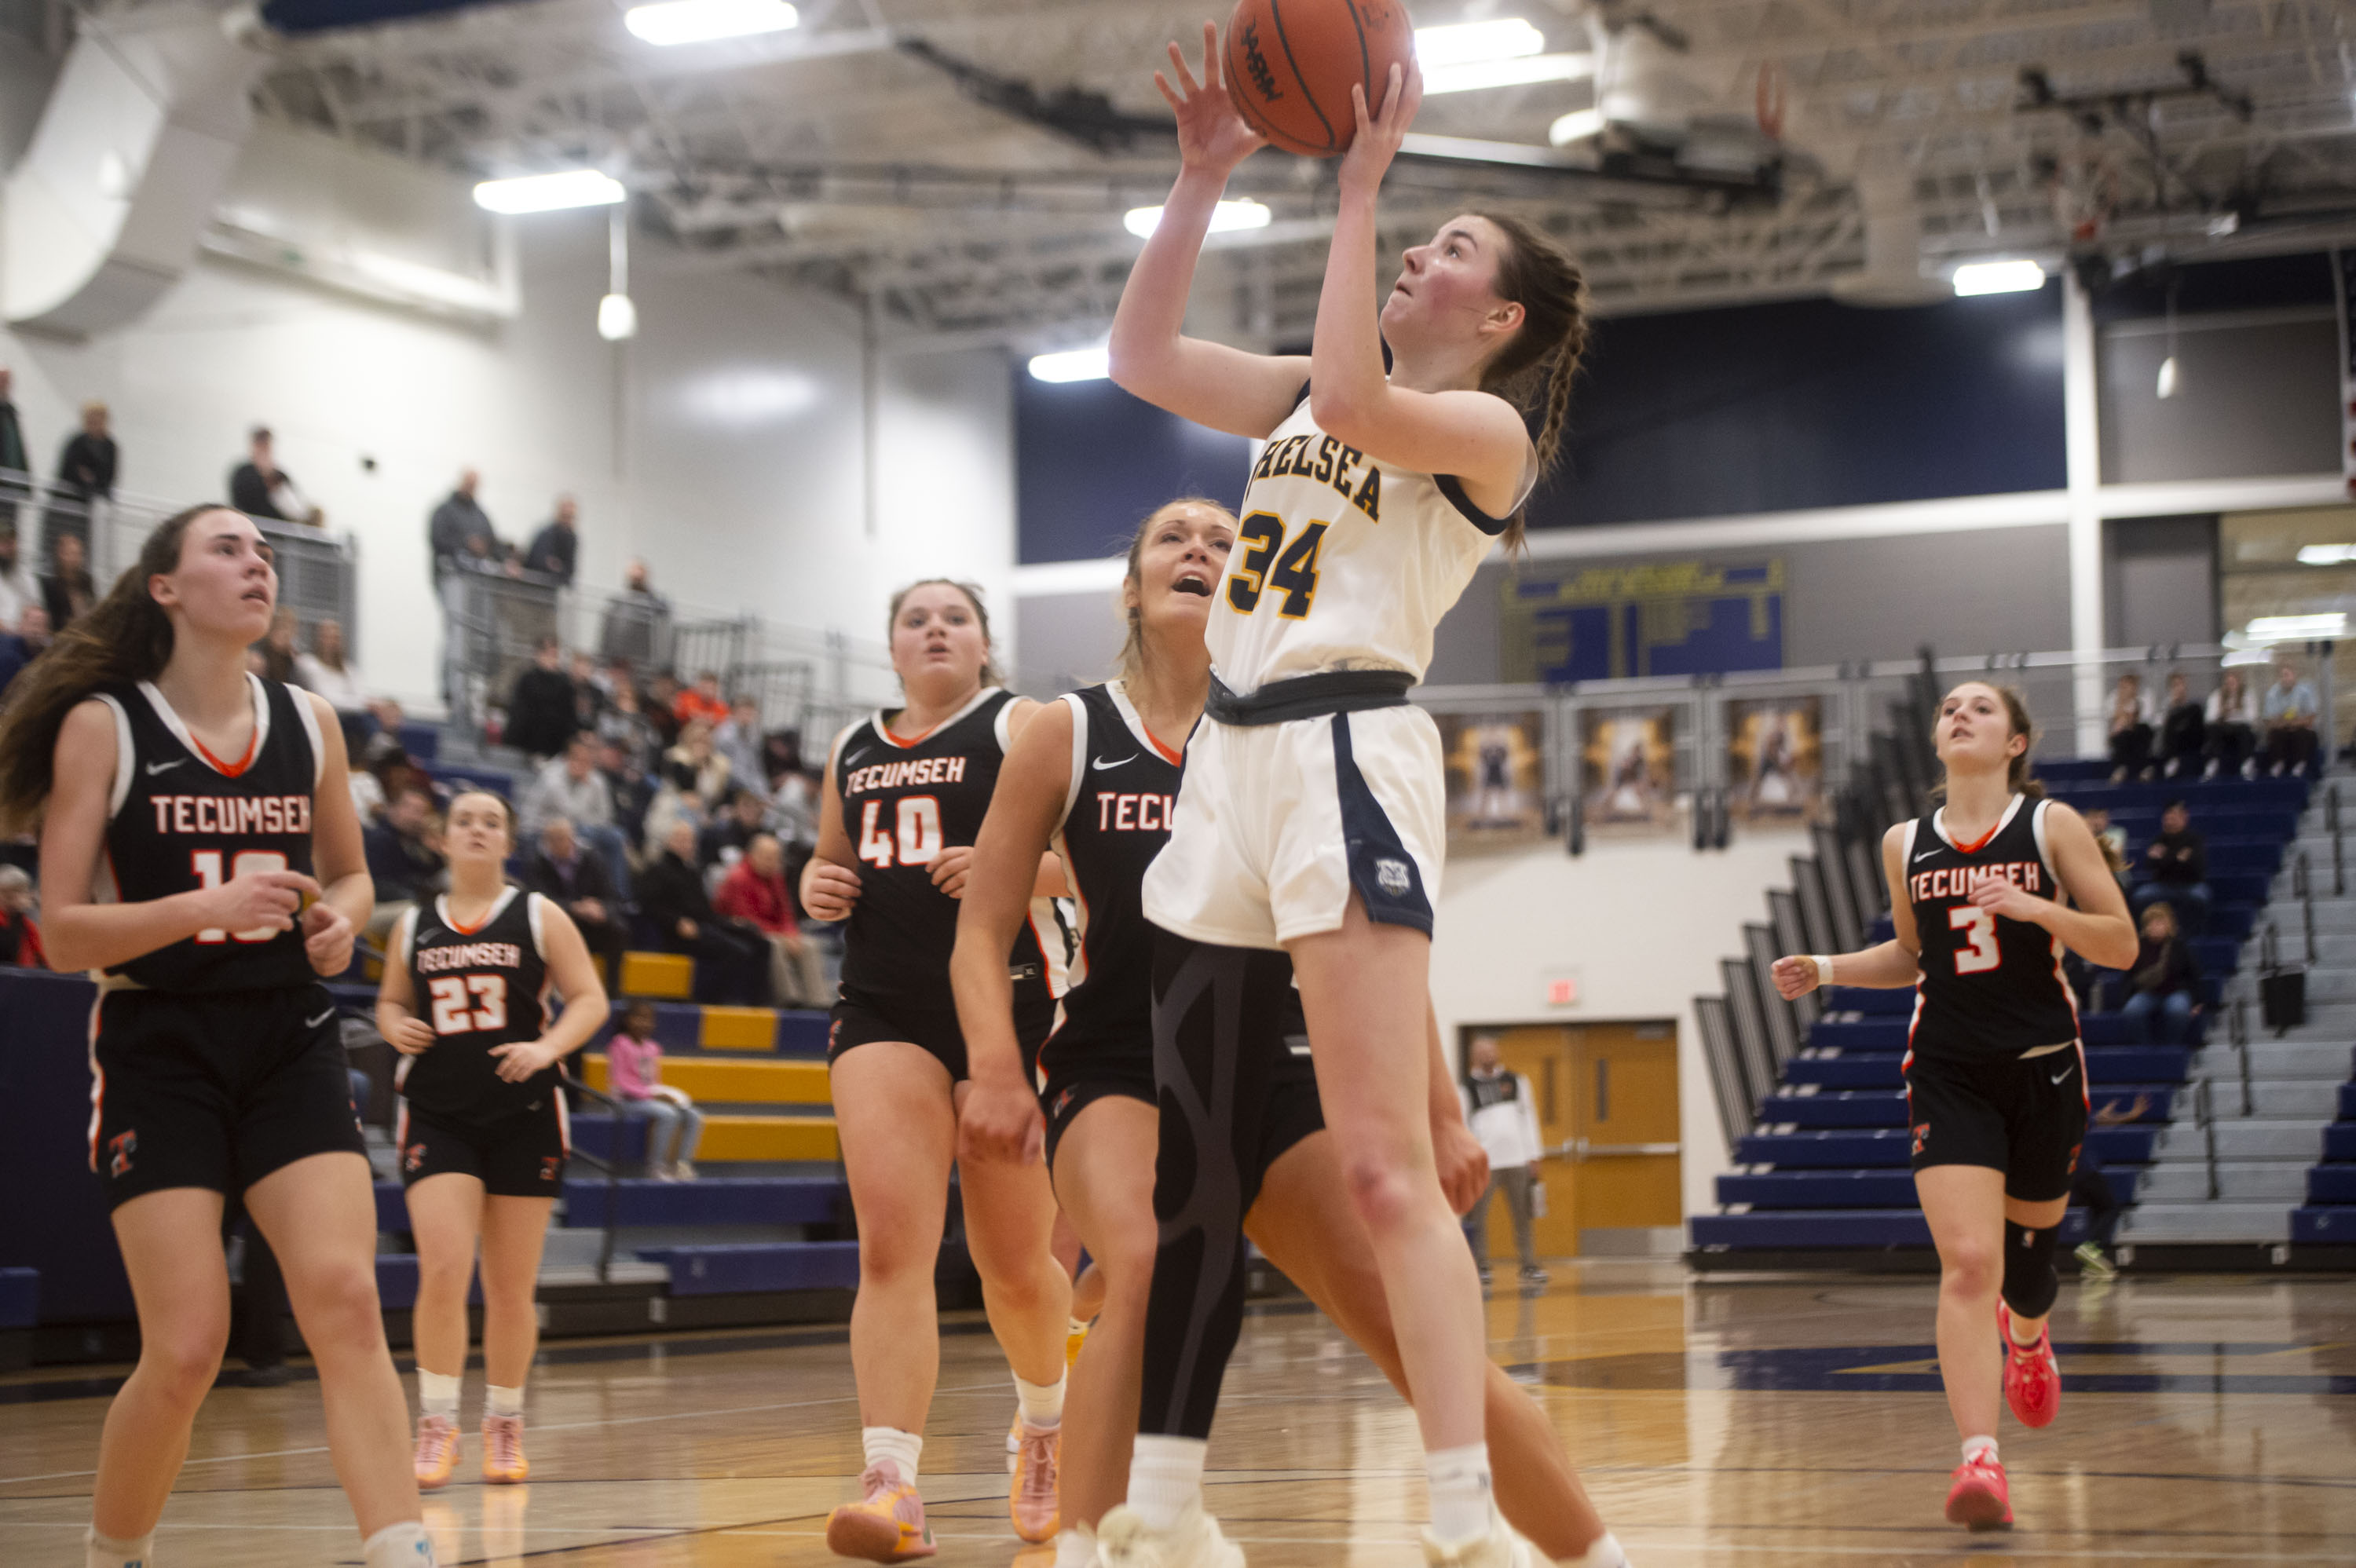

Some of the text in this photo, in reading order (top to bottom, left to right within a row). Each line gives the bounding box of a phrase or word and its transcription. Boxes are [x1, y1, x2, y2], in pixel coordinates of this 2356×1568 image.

[1245, 434, 1381, 524] HELSEA
[1225, 510, 1332, 621] 34
[845, 756, 966, 799] TECUMSEH
[149, 794, 312, 834] TECUMSEH
[858, 794, 945, 869] 40
[416, 942, 521, 974] TECUMSEH
[1947, 905, 2003, 975] 3
[427, 973, 508, 1037] 23
